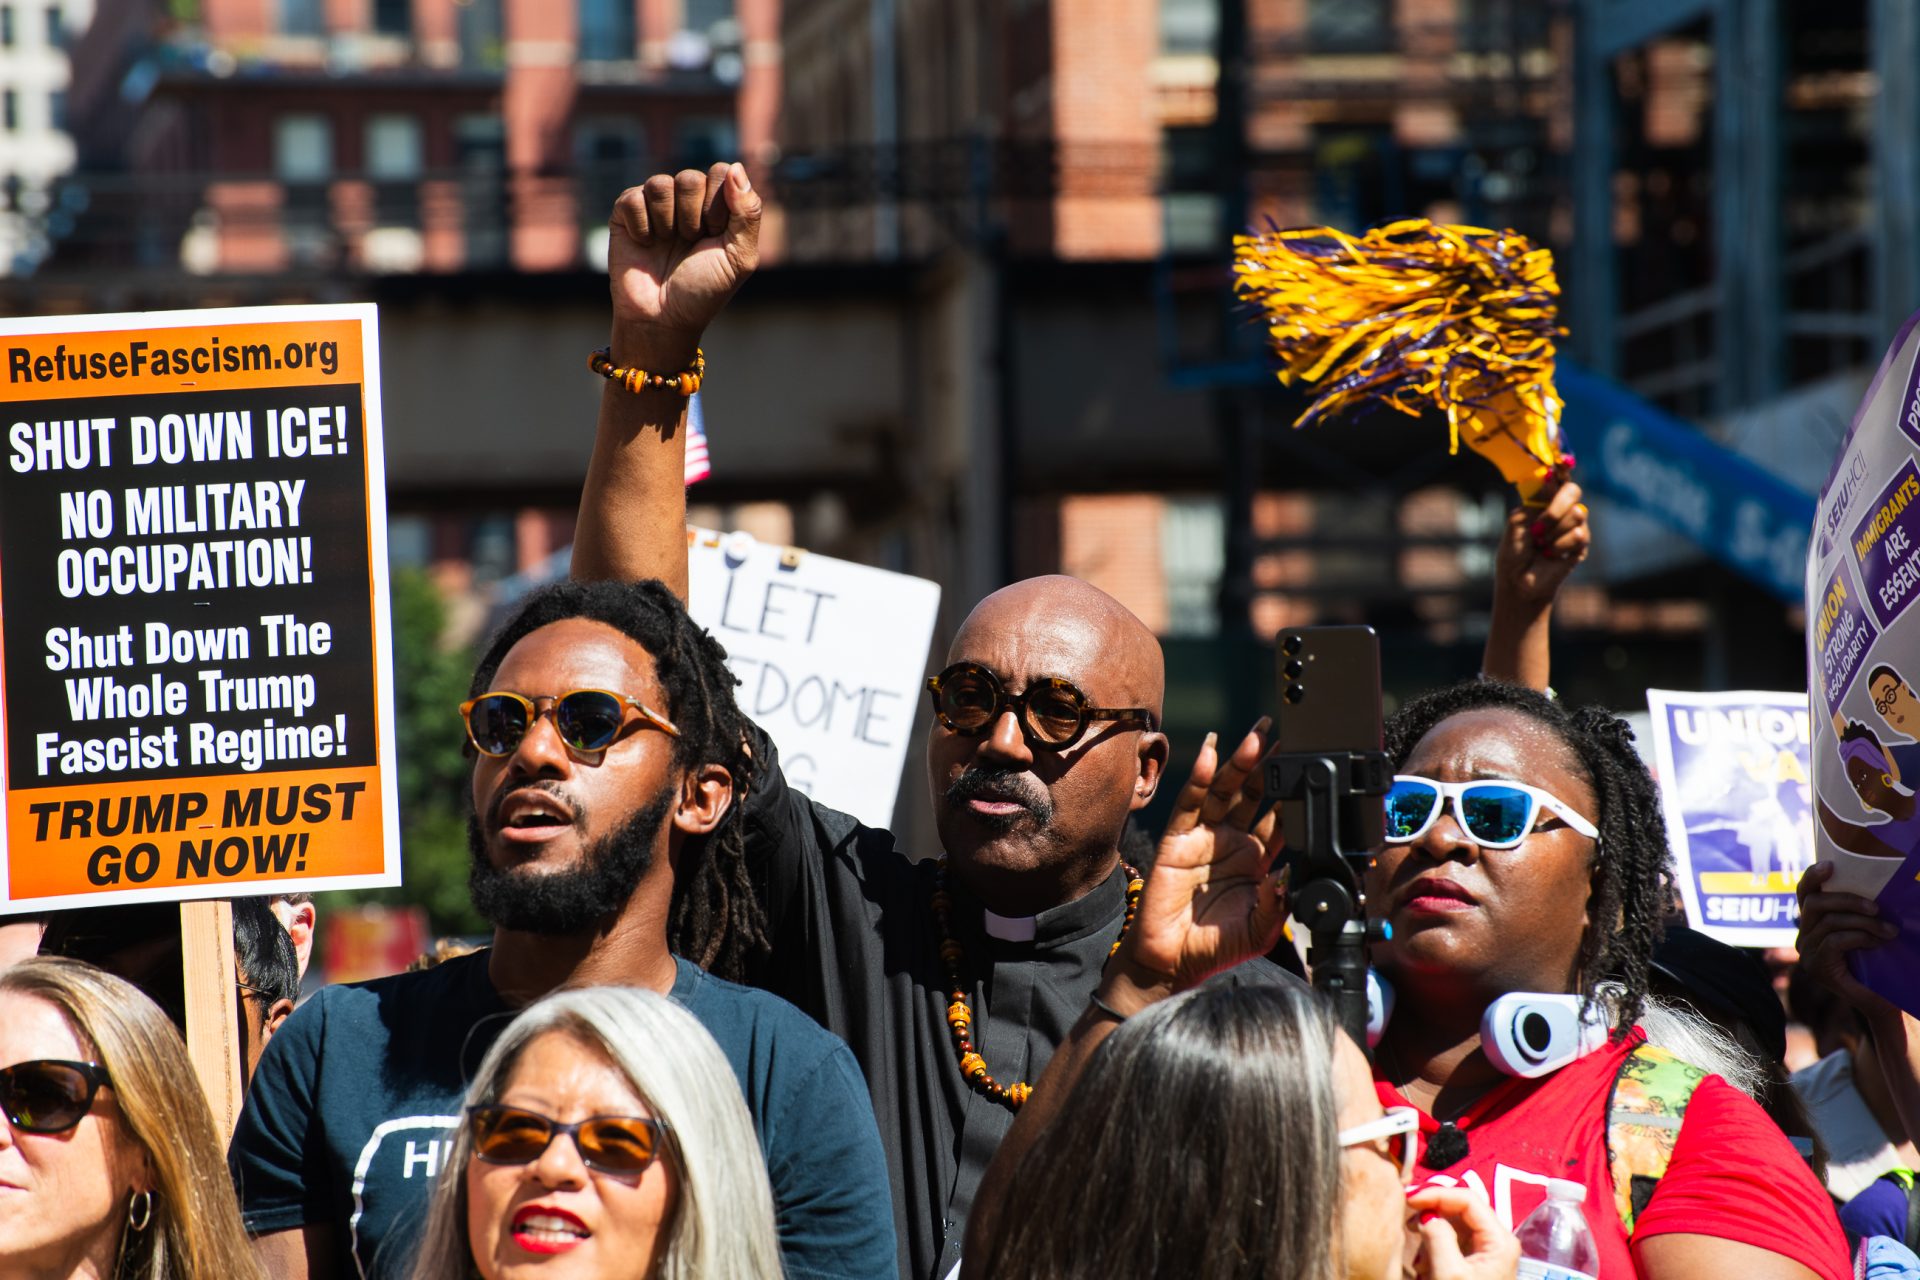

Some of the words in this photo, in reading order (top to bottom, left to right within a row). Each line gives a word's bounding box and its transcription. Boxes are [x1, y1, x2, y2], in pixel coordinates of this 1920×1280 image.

[8, 337, 339, 383] RefuseFascism.org
[9, 417, 116, 473] SHUT
[130, 410, 253, 465] DOWN
[266, 405, 348, 458] ICE!
[60, 489, 113, 540] NO
[124, 479, 306, 536] MILITARY
[1855, 474, 1920, 561] IMMIGRANTS
[57, 536, 313, 598] OCCUPATION!
[1885, 525, 1910, 565] ARE
[721, 568, 837, 643] LET
[1815, 575, 1847, 652] UNION
[45, 625, 134, 671] Shut
[145, 621, 250, 665] Down
[260, 614, 332, 658] The
[1824, 610, 1854, 675] STRONG
[1828, 620, 1869, 702] #SOLIDARITY
[64, 673, 188, 721] Whole
[197, 669, 316, 717] Trump
[36, 726, 179, 776] Fascist
[189, 714, 347, 772] Regime!
[29, 792, 209, 842] TRUMP
[221, 781, 366, 829] MUST
[86, 844, 161, 886] GO
[175, 833, 310, 880] NOW!
